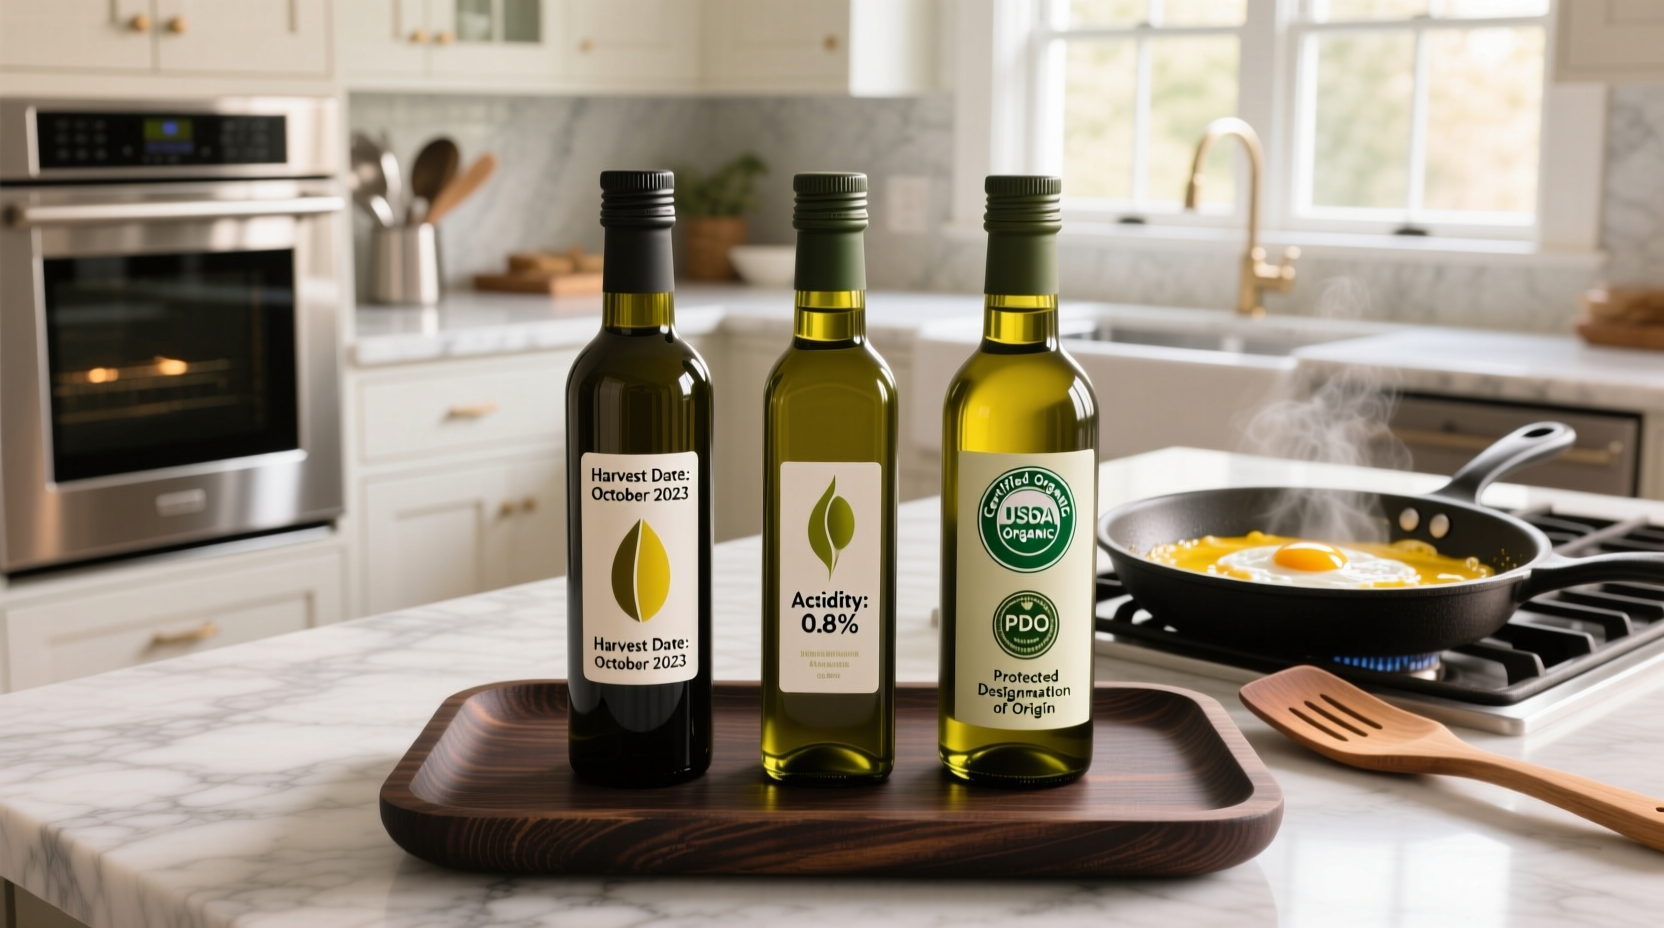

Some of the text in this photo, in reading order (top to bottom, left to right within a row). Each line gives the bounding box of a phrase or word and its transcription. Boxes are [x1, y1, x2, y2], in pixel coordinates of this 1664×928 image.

[591, 468, 690, 482] Harvest Date:
[591, 486, 689, 502] October 2023
[801, 613, 859, 635] 0.8%
[1005, 614, 1049, 632] PDO
[594, 636, 689, 652] Harvest Date:
[594, 654, 687, 671] October 2023
[993, 669, 1059, 683] Protected
[993, 701, 1055, 719] of Origin
